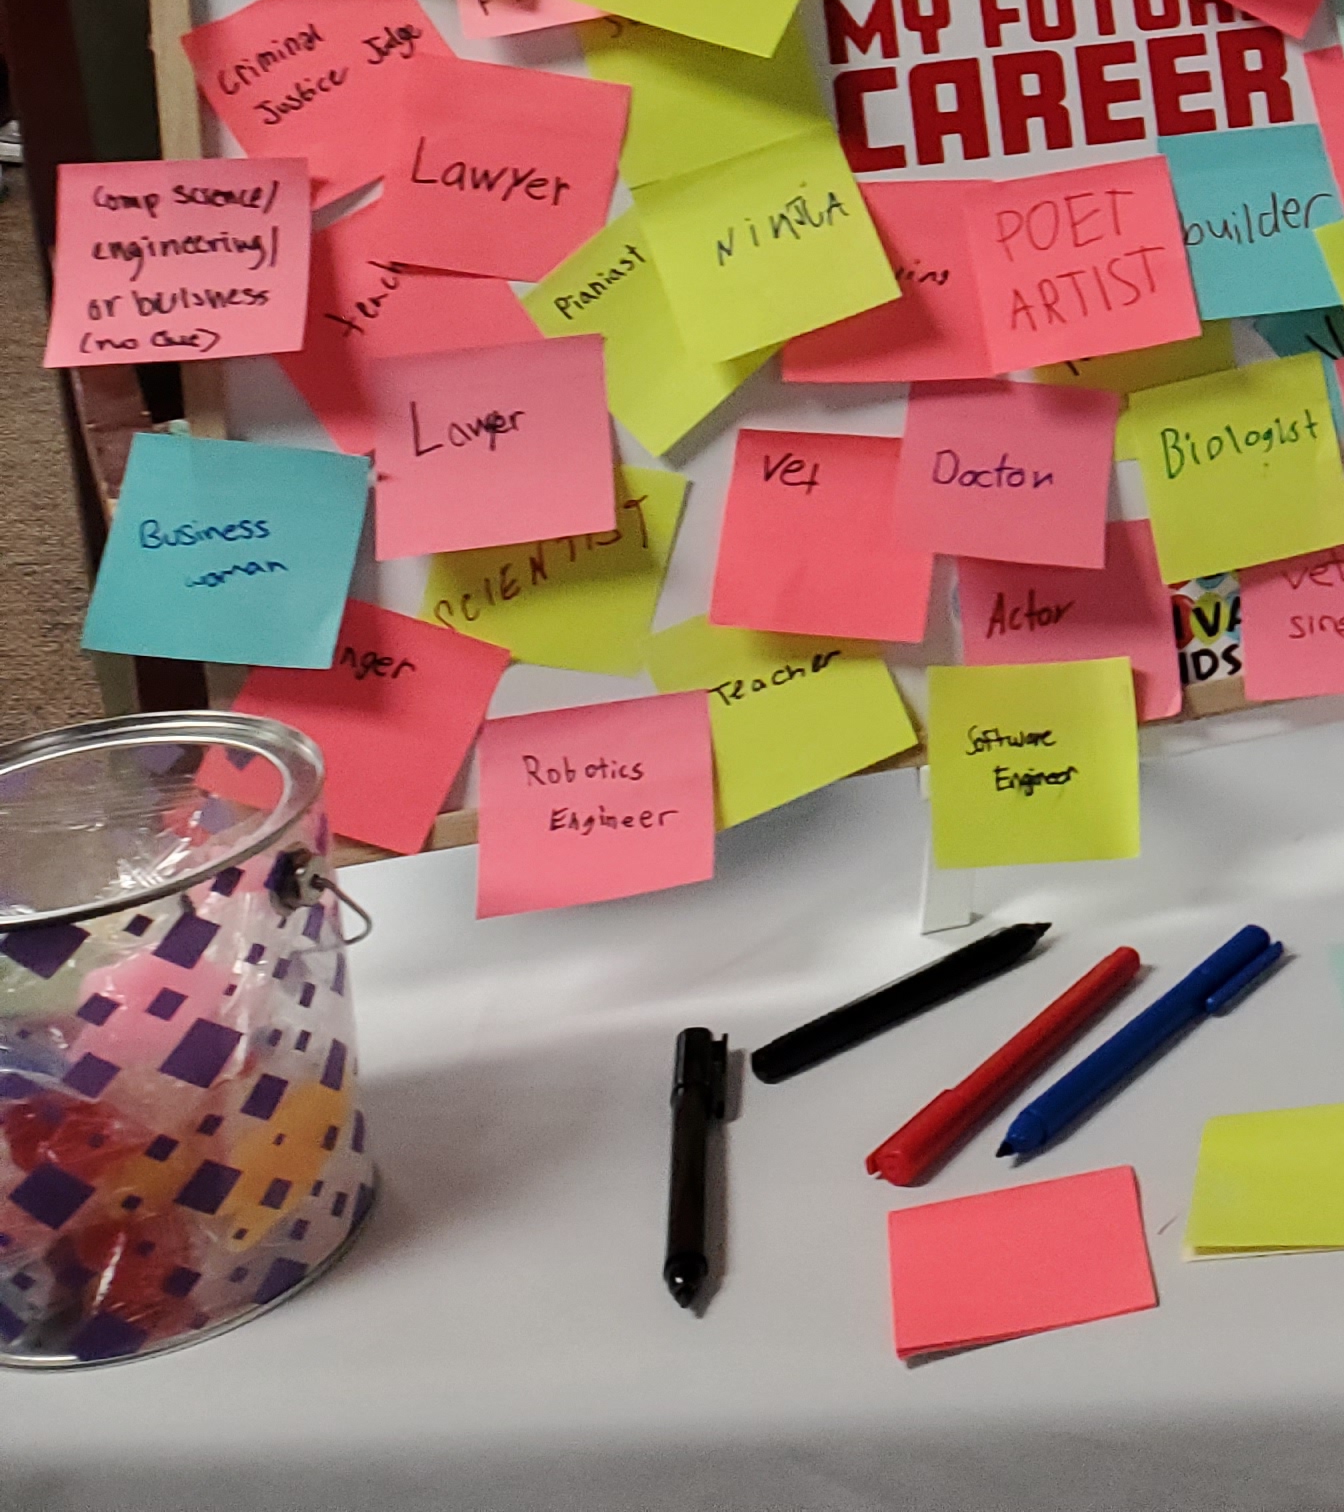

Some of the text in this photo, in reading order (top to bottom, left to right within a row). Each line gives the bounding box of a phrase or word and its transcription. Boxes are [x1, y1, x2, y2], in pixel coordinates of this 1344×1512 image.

[218, 22, 325, 98] Criminal
[833, 25, 1295, 174] CAREER
[410, 134, 571, 209] Lawyer
[994, 187, 1137, 264] POET
[1009, 245, 1166, 333] ARTIST
[930, 448, 1056, 490] Doctor
[1160, 408, 1320, 480] Biologist
[139, 518, 271, 549] Business
[985, 592, 1075, 640] Actor
[706, 649, 844, 708] Teacher
[521, 752, 646, 787] Robotics
